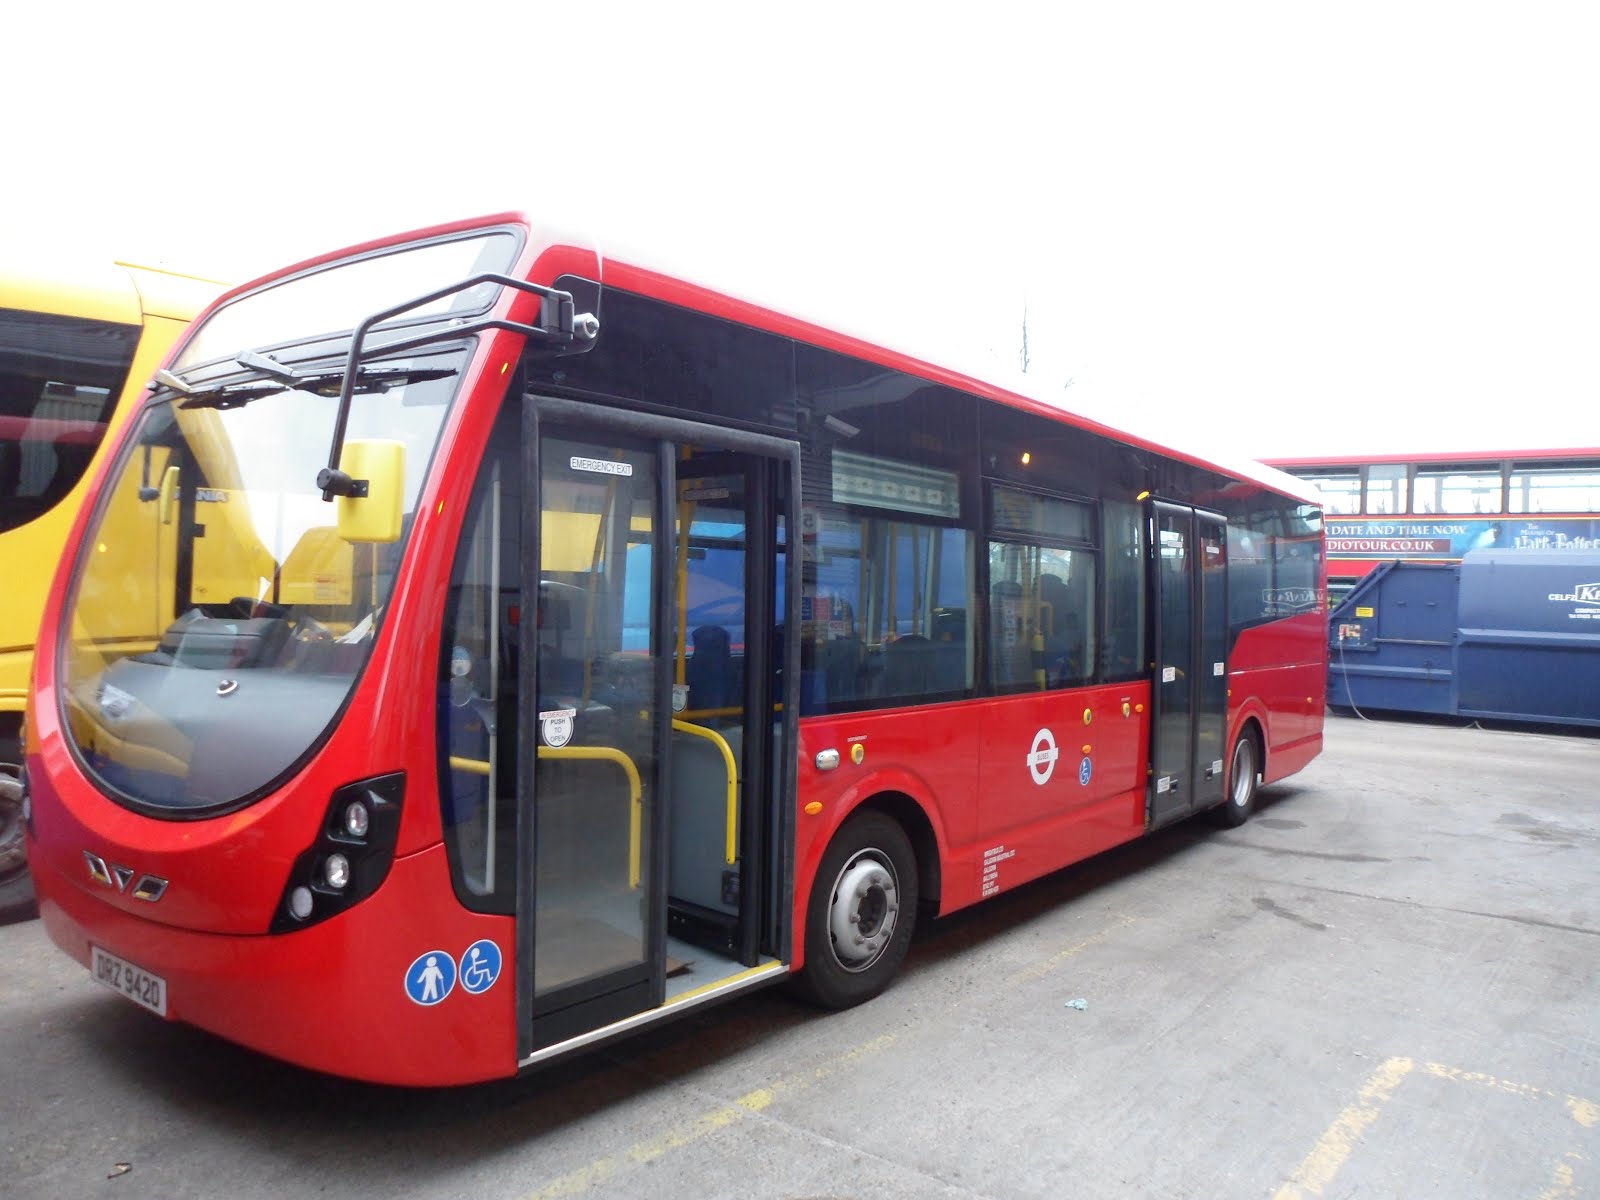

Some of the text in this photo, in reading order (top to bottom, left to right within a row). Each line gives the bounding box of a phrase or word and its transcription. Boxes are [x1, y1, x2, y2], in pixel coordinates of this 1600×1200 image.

[572, 457, 632, 475] EMERGENCY EXIT
[1331, 525, 1364, 535] DATE
[1365, 525, 1395, 535] AND
[1397, 525, 1430, 535] TIME
[1432, 525, 1466, 535] NOW
[1326, 540, 1434, 551] DIOTOUR.CO.UK
[124, 967, 160, 1007] 9420
